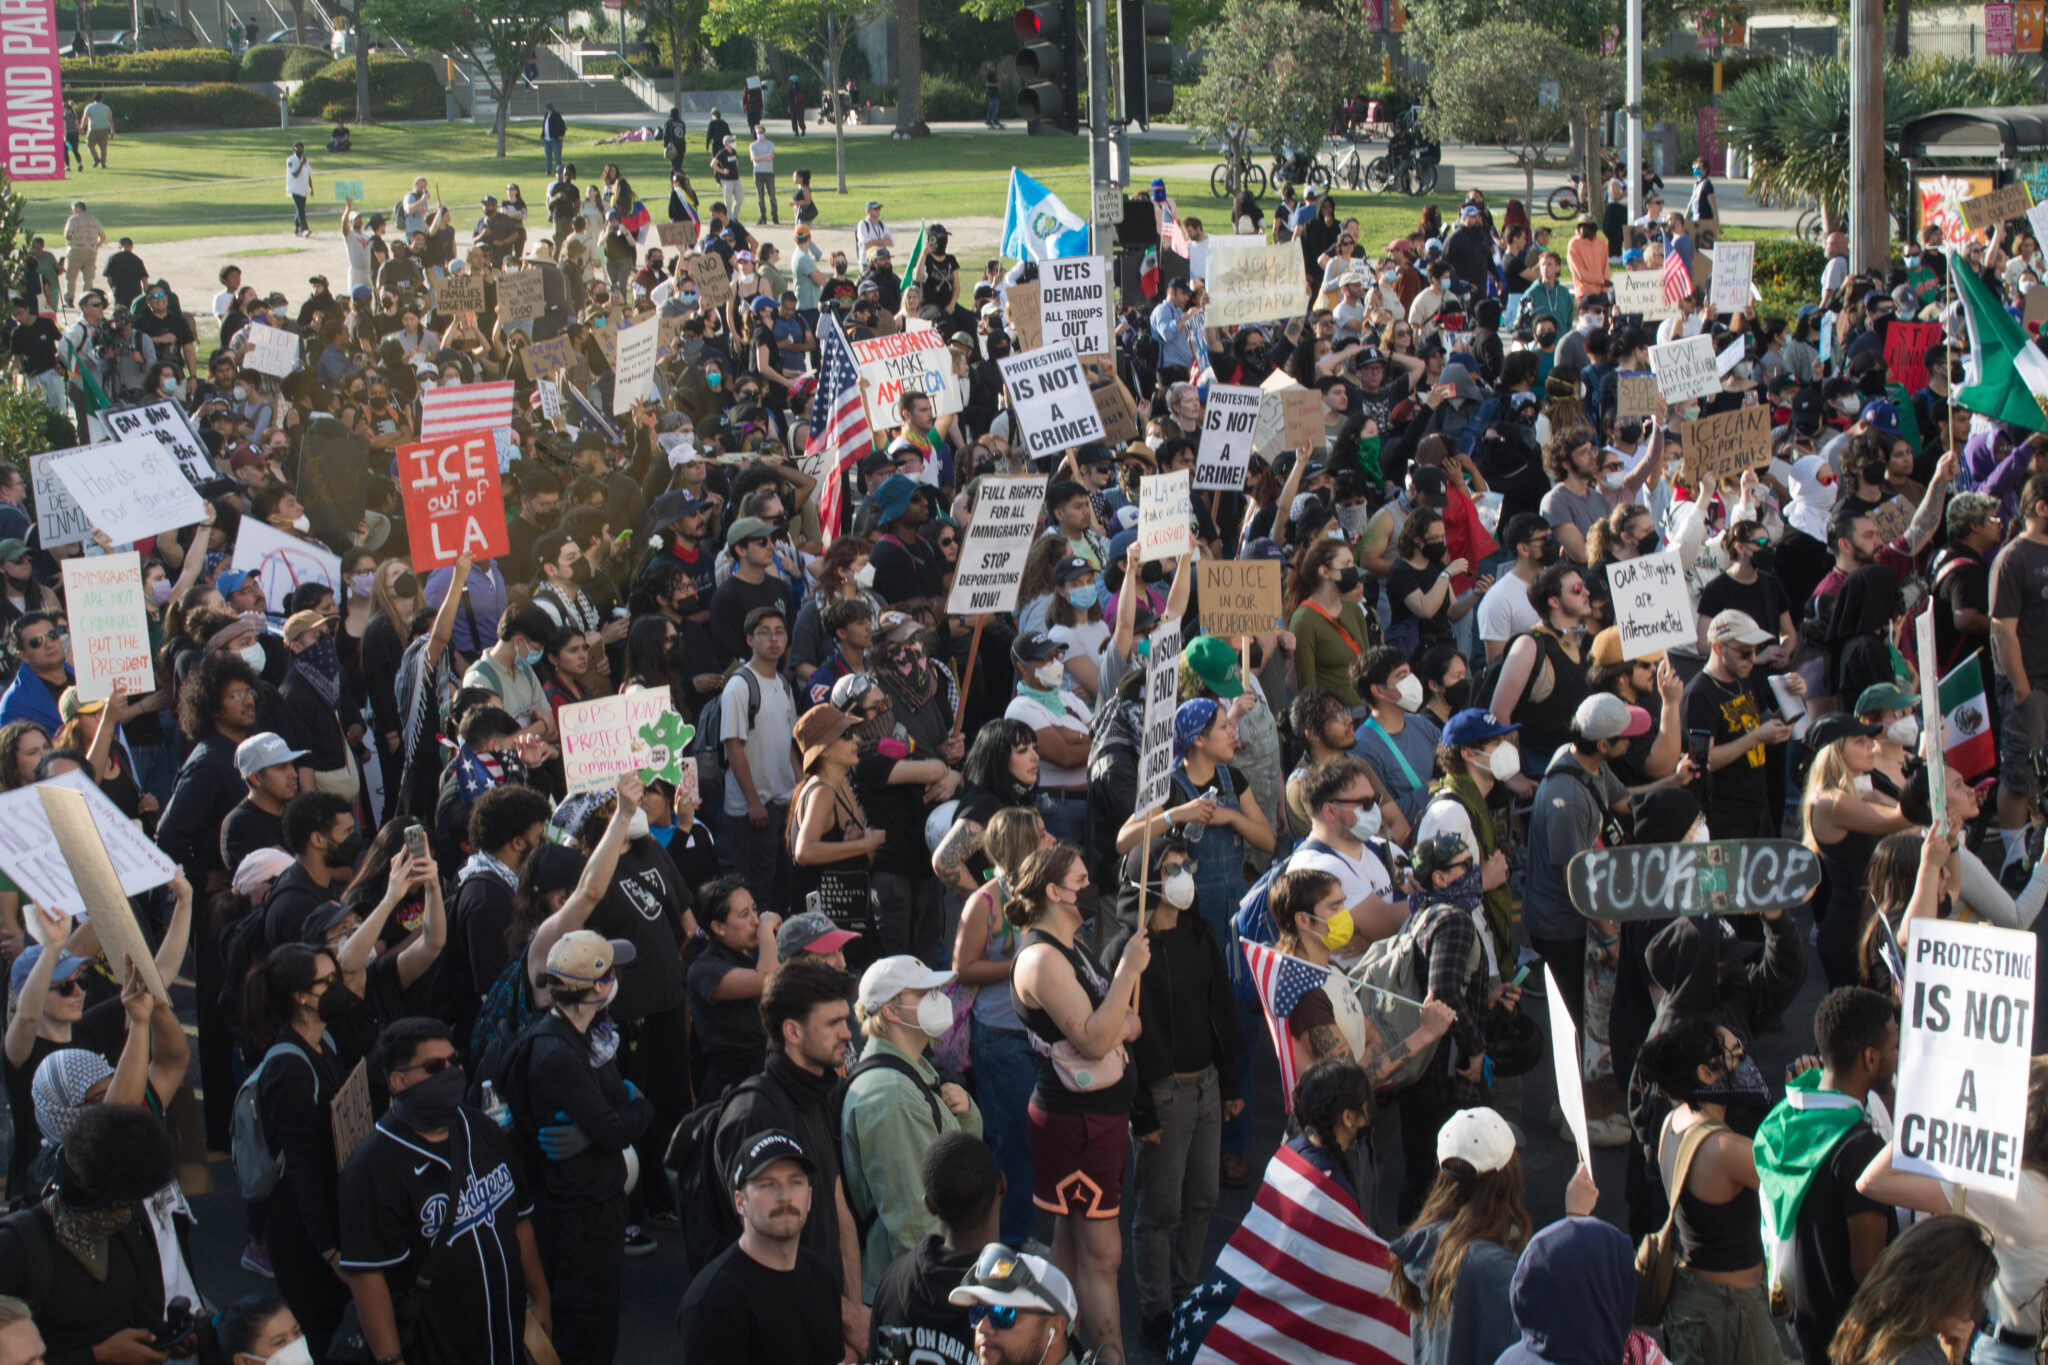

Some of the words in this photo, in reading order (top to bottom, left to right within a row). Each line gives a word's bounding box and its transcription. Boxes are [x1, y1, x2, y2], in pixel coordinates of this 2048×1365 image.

[0, 0, 51, 55] PAR
[5, 66, 57, 175] GRAND
[1099, 193, 1118, 201] LOOK
[1100, 211, 1119, 219] WAYS
[697, 257, 717, 274] NO
[1237, 255, 1277, 275] YOU
[1718, 248, 1750, 264] Liberty
[1053, 262, 1091, 281] VETS
[447, 277, 471, 290] KEEP
[1626, 274, 1665, 291] America
[1718, 276, 1748, 288] Justice
[440, 288, 481, 300] FAMILIES
[1043, 285, 1103, 303] DEMAND
[438, 300, 482, 312] TOGETHER
[510, 305, 533, 317] TODO
[1045, 311, 1063, 323] ALL
[1065, 307, 1103, 321] TROOPS
[1062, 320, 1088, 338] OUT
[258, 328, 295, 352] STOP
[853, 328, 945, 365] IMMIGRANTS
[1075, 336, 1099, 353] LA!
[259, 346, 281, 361] THE
[1004, 347, 1073, 376] PROTESTING
[885, 353, 927, 378] MAKE
[877, 370, 946, 406] AMERICA
[1011, 379, 1035, 402] IS
[1038, 364, 1079, 394] NOT
[1621, 379, 1655, 396] STOP
[1210, 391, 1260, 407] PROTESTING
[1627, 397, 1656, 410] ICE
[145, 405, 171, 427] the
[1050, 402, 1064, 421] A
[1206, 410, 1222, 430] IS
[1226, 412, 1257, 433] NOT
[1029, 415, 1099, 452] CRIME!
[1691, 418, 1721, 446] ICE
[1725, 409, 1764, 437] CAN
[1220, 443, 1230, 461] A
[410, 438, 486, 491] ICE
[1196, 464, 1245, 485] CRIME!
[37, 478, 56, 496] DE
[69, 459, 136, 501] Hands
[427, 484, 460, 512] out
[465, 478, 490, 507] of
[981, 485, 1005, 501] FULL
[1008, 485, 1044, 500] RIGHTS
[1155, 479, 1169, 503] LA
[48, 494, 68, 511] DE
[990, 505, 1010, 519] FOR
[1010, 505, 1025, 518] ALL
[1144, 508, 1163, 524] take
[431, 515, 489, 560] LA
[970, 523, 1034, 538] IMMIGRANTS!
[1146, 524, 1185, 548] CRUSHED
[981, 552, 1010, 569] STOP
[70, 567, 140, 589] IMMIGRANTS
[959, 572, 1020, 586] DEPORTATIONS
[1208, 566, 1233, 589] NO
[1240, 566, 1267, 589] ICE
[1614, 564, 1638, 588] OUR
[82, 590, 104, 608] ARE
[110, 589, 134, 607] NOT
[970, 591, 1000, 609] NOW!
[1219, 594, 1231, 609] IN
[1235, 593, 1259, 609] OUR
[1635, 591, 1654, 608] are
[80, 614, 139, 633] CRIMINALS
[1201, 613, 1277, 635] NEIGHBORHOOD
[1621, 608, 1684, 642] interconnected
[88, 635, 112, 656] BUT
[115, 633, 140, 651] THE
[90, 655, 149, 681] PRESIDENT
[562, 701, 616, 731] COPS
[565, 724, 633, 754] PROTECT
[1584, 845, 1697, 911] FUCK
[1735, 845, 1813, 908] ICE
[1916, 938, 2032, 981] PROTESTING
[1912, 981, 1952, 1033] IS
[1963, 989, 2030, 1048] NOT
[1955, 1068, 1977, 1113] A
[1900, 1113, 2018, 1181] CRIME!
[420, 1162, 515, 1239] Dodgers
[915, 1326, 936, 1350] ON
[938, 1331, 965, 1365] BAIL
